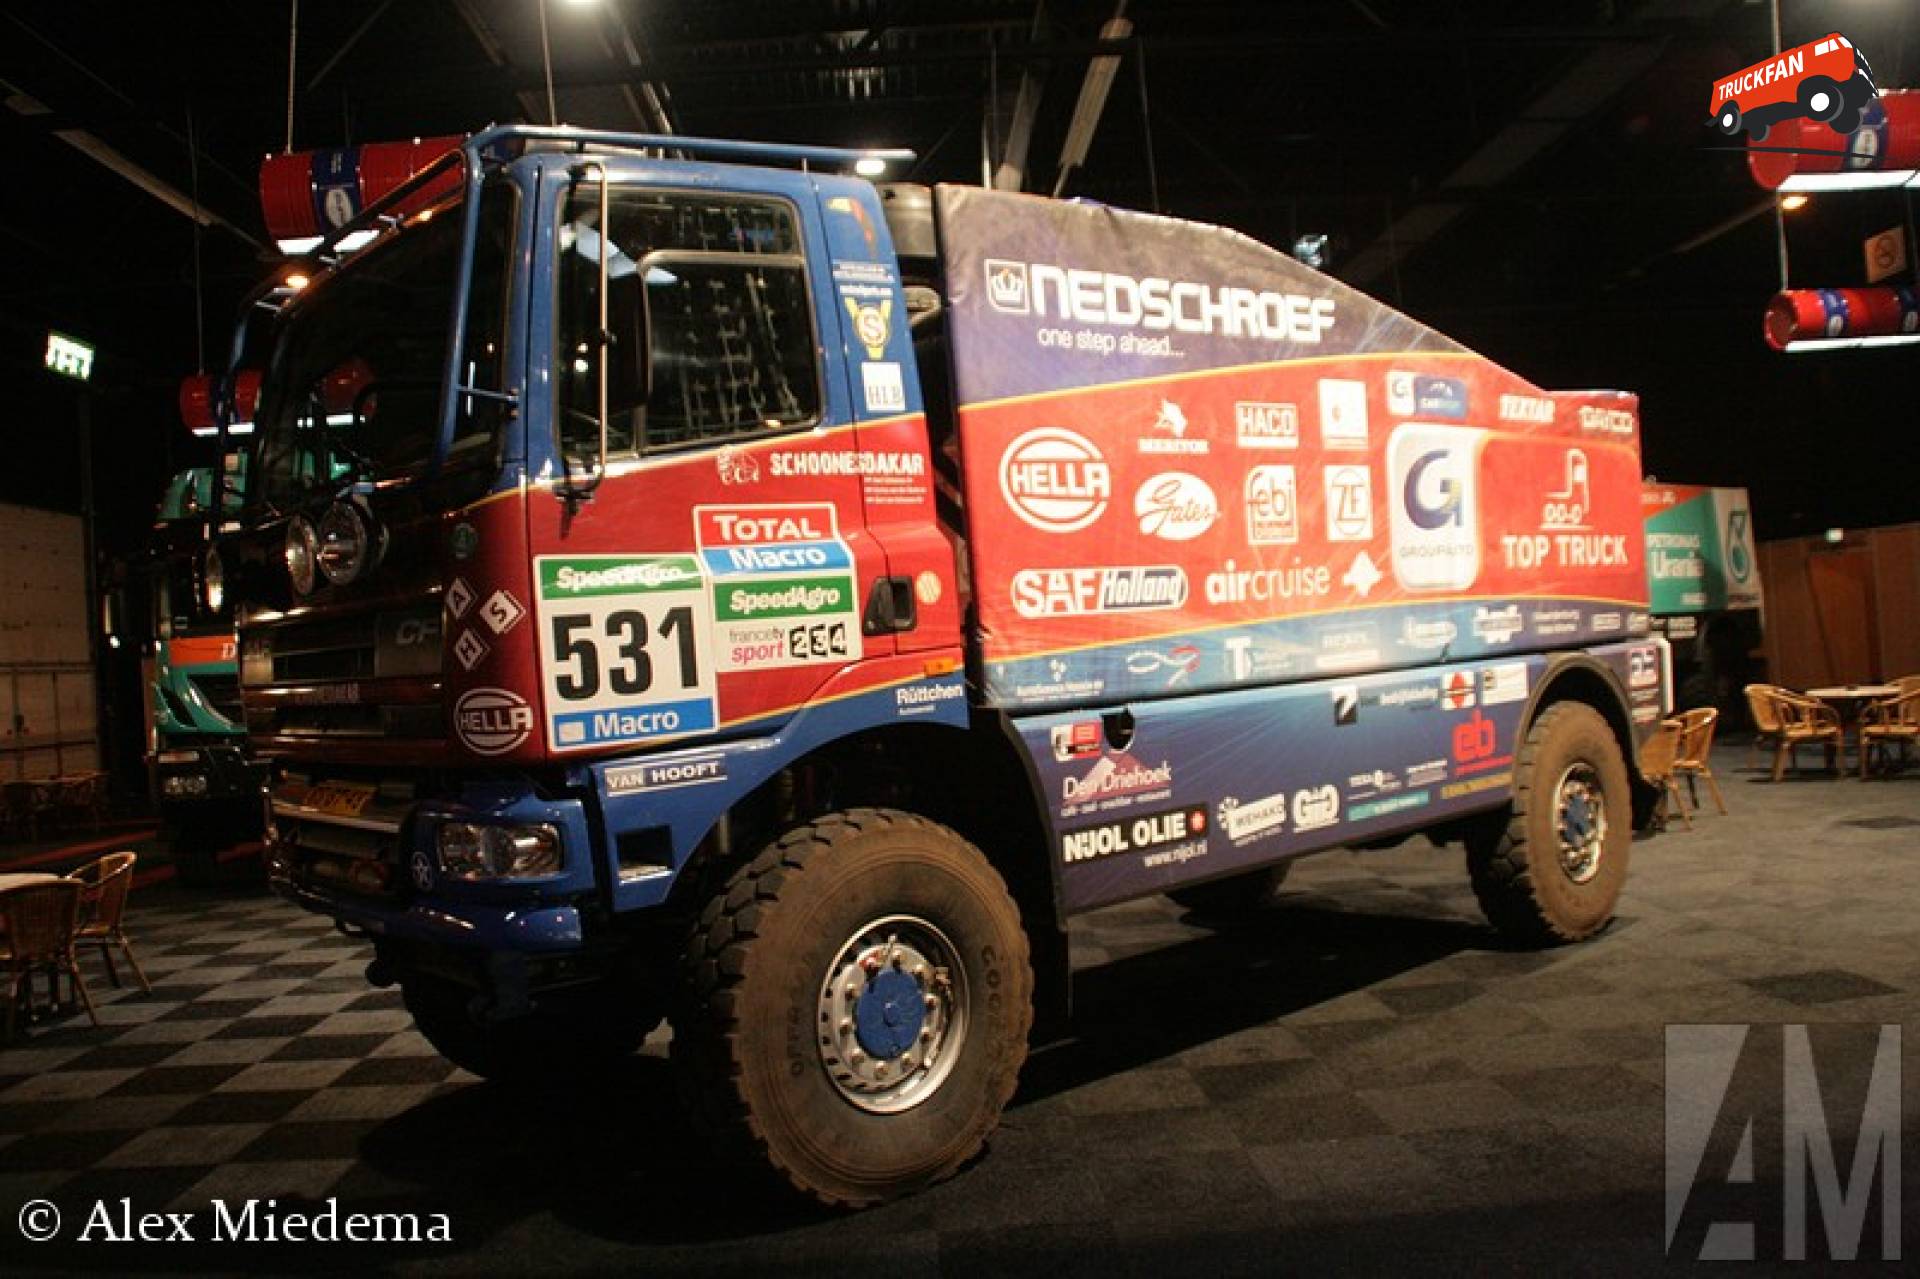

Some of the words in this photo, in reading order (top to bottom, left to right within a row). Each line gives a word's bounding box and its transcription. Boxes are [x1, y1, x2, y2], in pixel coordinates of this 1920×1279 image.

[1031, 263, 1335, 343] NEDSCHROEF
[1038, 327, 1073, 348] one
[1077, 327, 1117, 356] step
[1238, 406, 1295, 436] HACO
[1010, 462, 1111, 498] HELLA
[712, 513, 822, 542] TOTAL
[728, 546, 827, 570] Macro
[1502, 535, 1550, 568] TOP
[1556, 535, 1628, 567] TRUCK
[729, 584, 841, 615] SpeedAgro
[1014, 568, 1098, 617] SAF
[1101, 569, 1183, 603] Holland
[551, 606, 699, 701] 531
[732, 642, 784, 666] sport
[789, 621, 848, 660] 234
[460, 706, 534, 733] HELLA
[594, 709, 680, 738] Macro
[606, 773, 644, 790] VAN
[651, 761, 719, 783] HOOFT
[1132, 811, 1187, 847] OLIE
